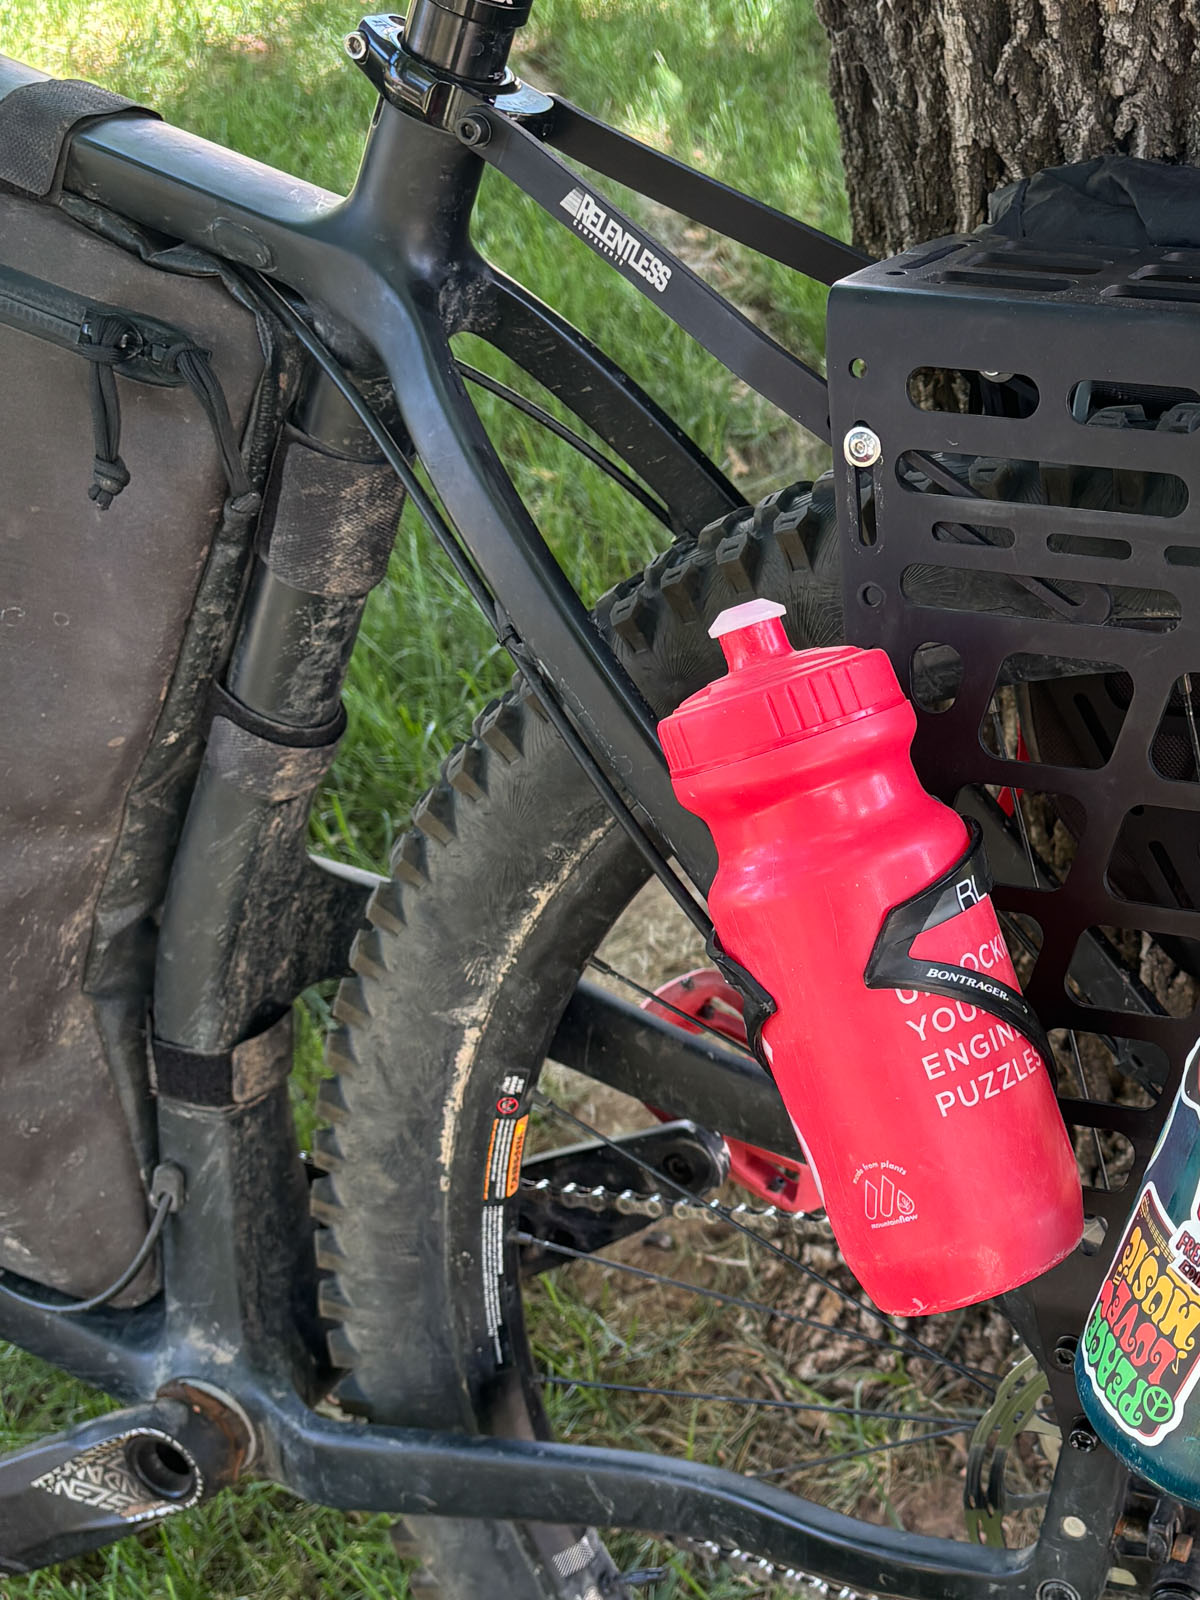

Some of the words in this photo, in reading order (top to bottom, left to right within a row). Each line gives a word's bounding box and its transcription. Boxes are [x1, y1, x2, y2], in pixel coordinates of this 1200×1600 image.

[572, 219, 624, 266] COMPONENTS
[576, 193, 673, 293] RELENTLESS
[905, 1000, 988, 1041] YOU
[921, 1023, 1022, 1080] ENGIN
[935, 1046, 1042, 1117] PUZZLES
[880, 1160, 907, 1176] plants
[1084, 1301, 1149, 1427] PEACE
